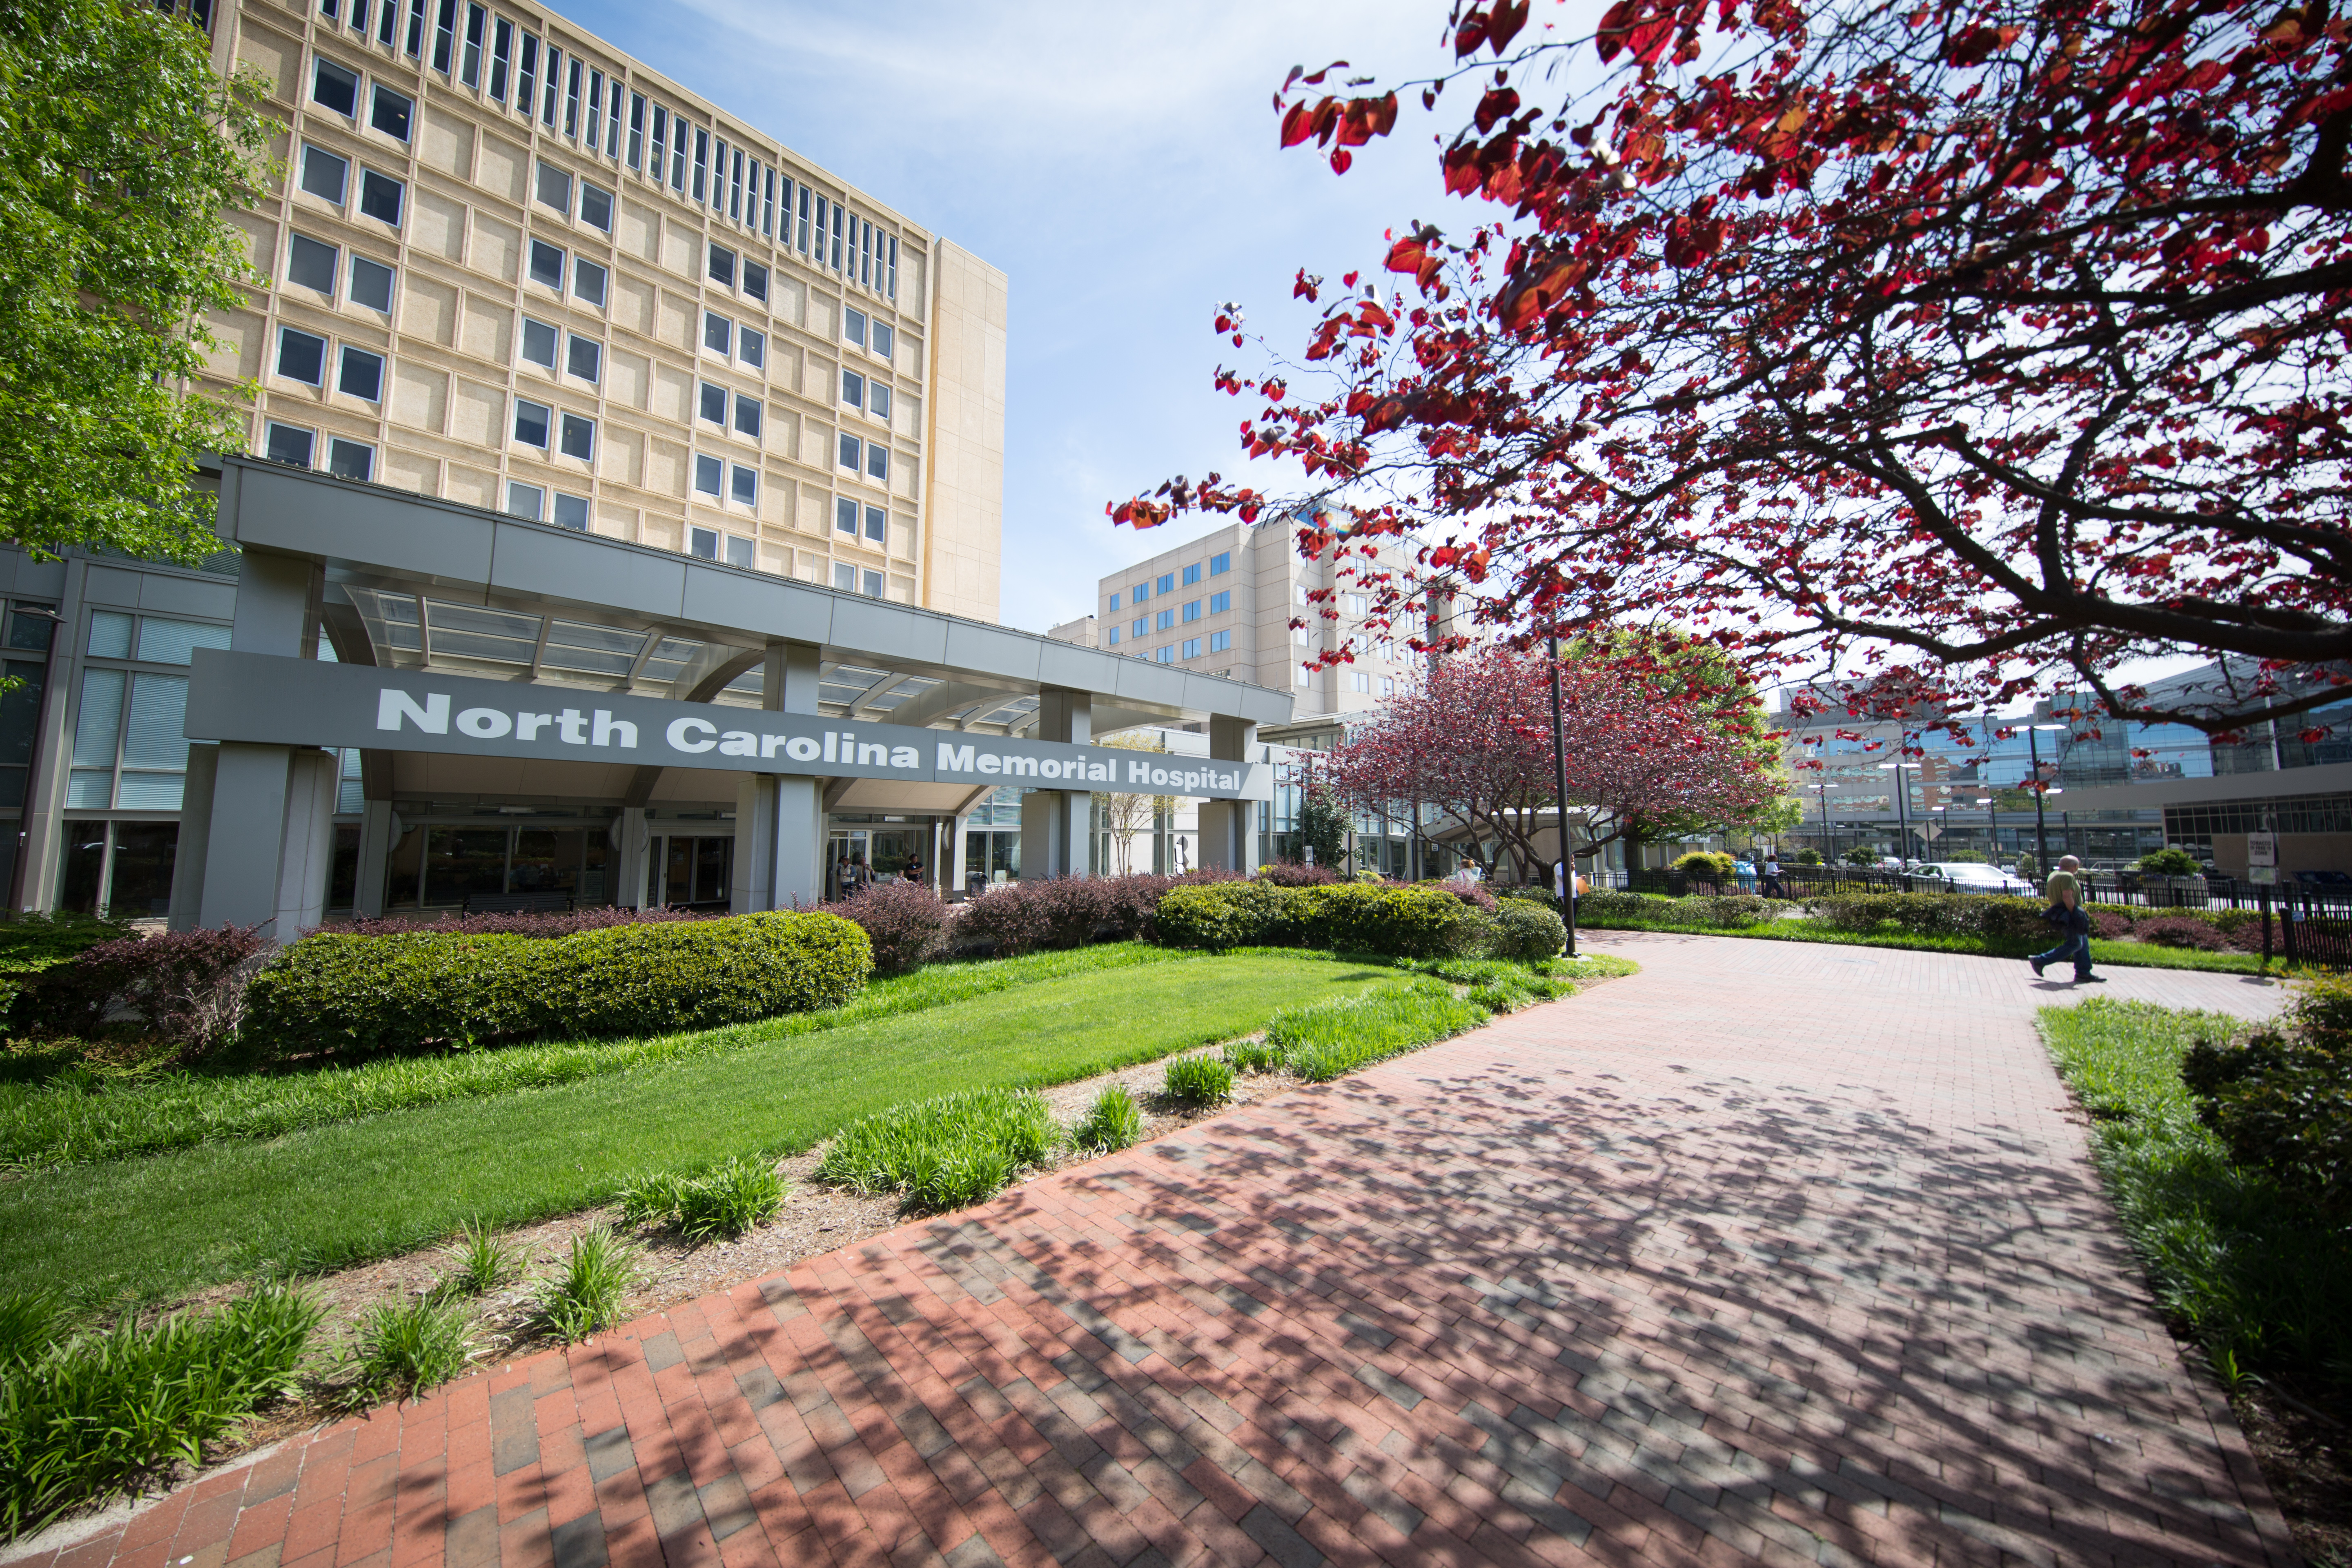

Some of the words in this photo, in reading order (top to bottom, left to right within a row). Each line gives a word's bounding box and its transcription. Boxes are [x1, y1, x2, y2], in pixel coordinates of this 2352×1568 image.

[376, 688, 638, 748] North
[666, 717, 920, 768] Carolina
[937, 742, 1116, 782] Memorial
[1128, 760, 1240, 792] Hospital
